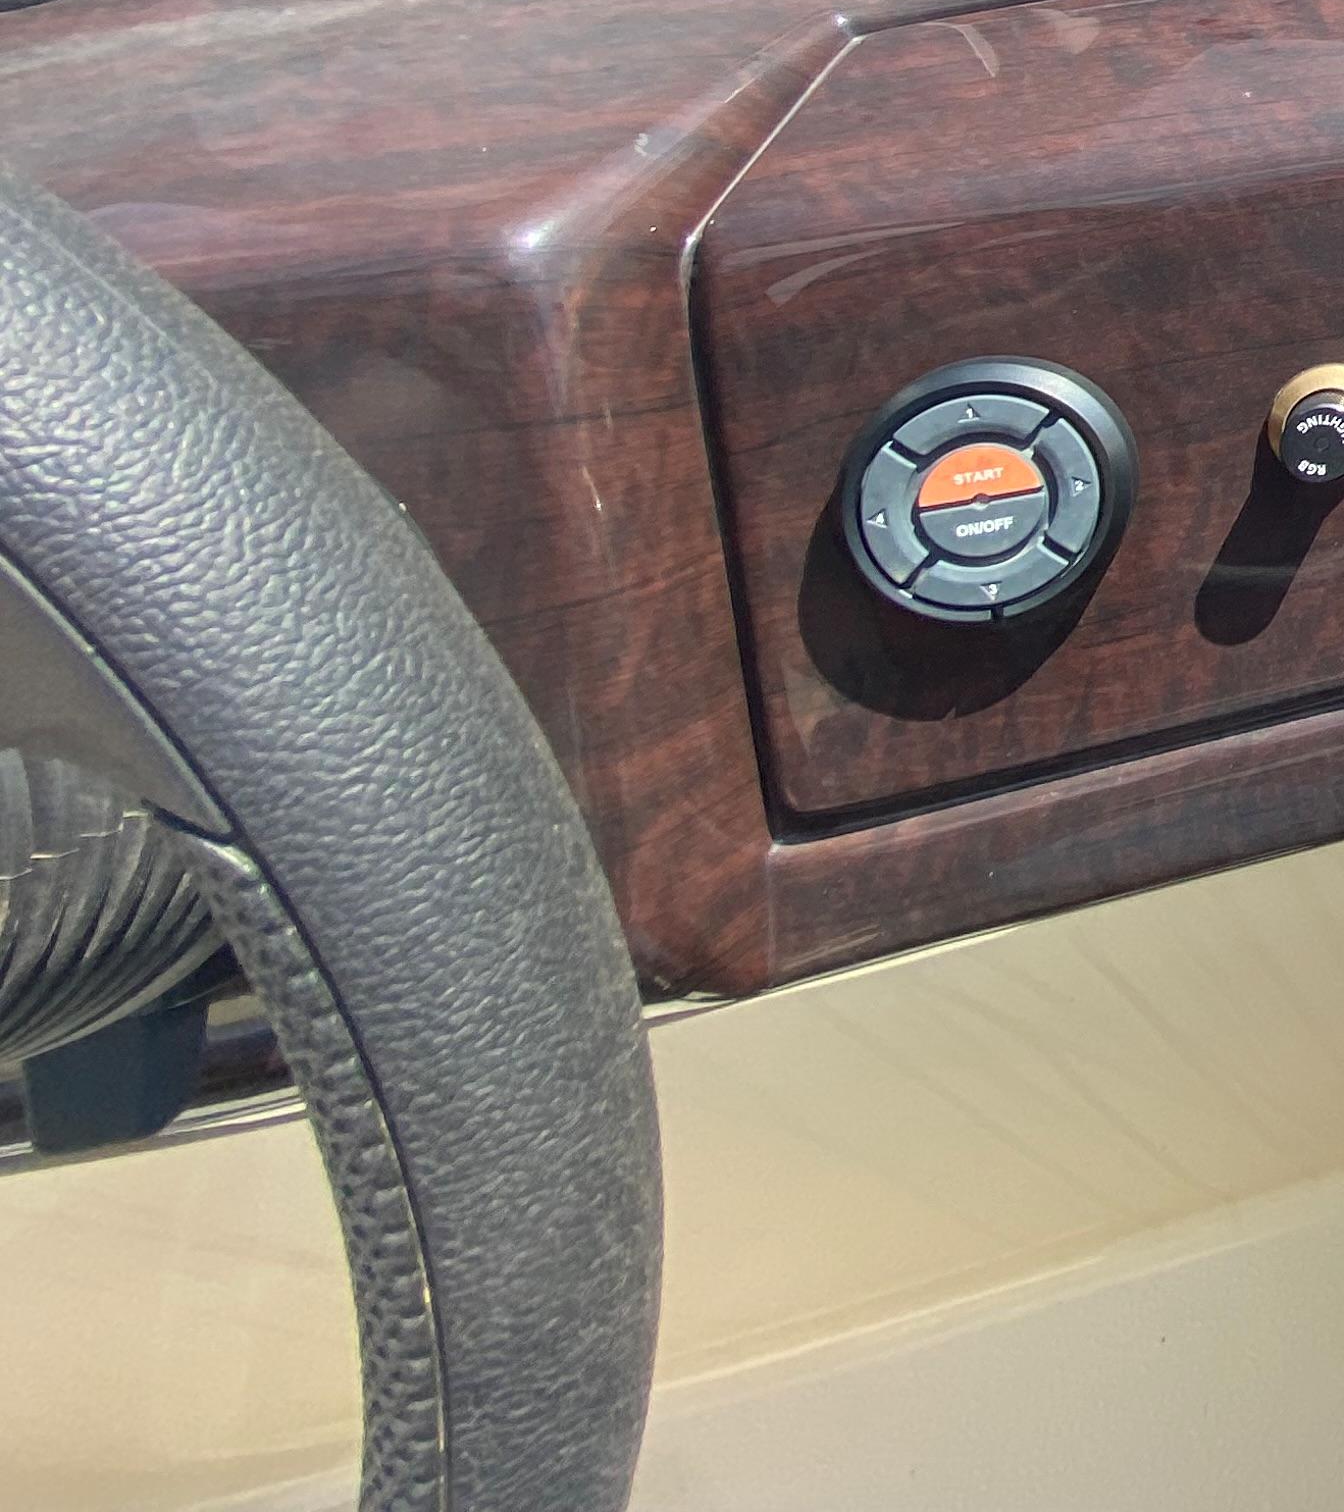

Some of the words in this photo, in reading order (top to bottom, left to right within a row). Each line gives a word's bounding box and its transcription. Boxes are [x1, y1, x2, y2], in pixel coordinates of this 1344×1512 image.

[953, 467, 1004, 485] START
[1298, 459, 1327, 476] RGB
[956, 516, 1014, 537] ON/OFF
